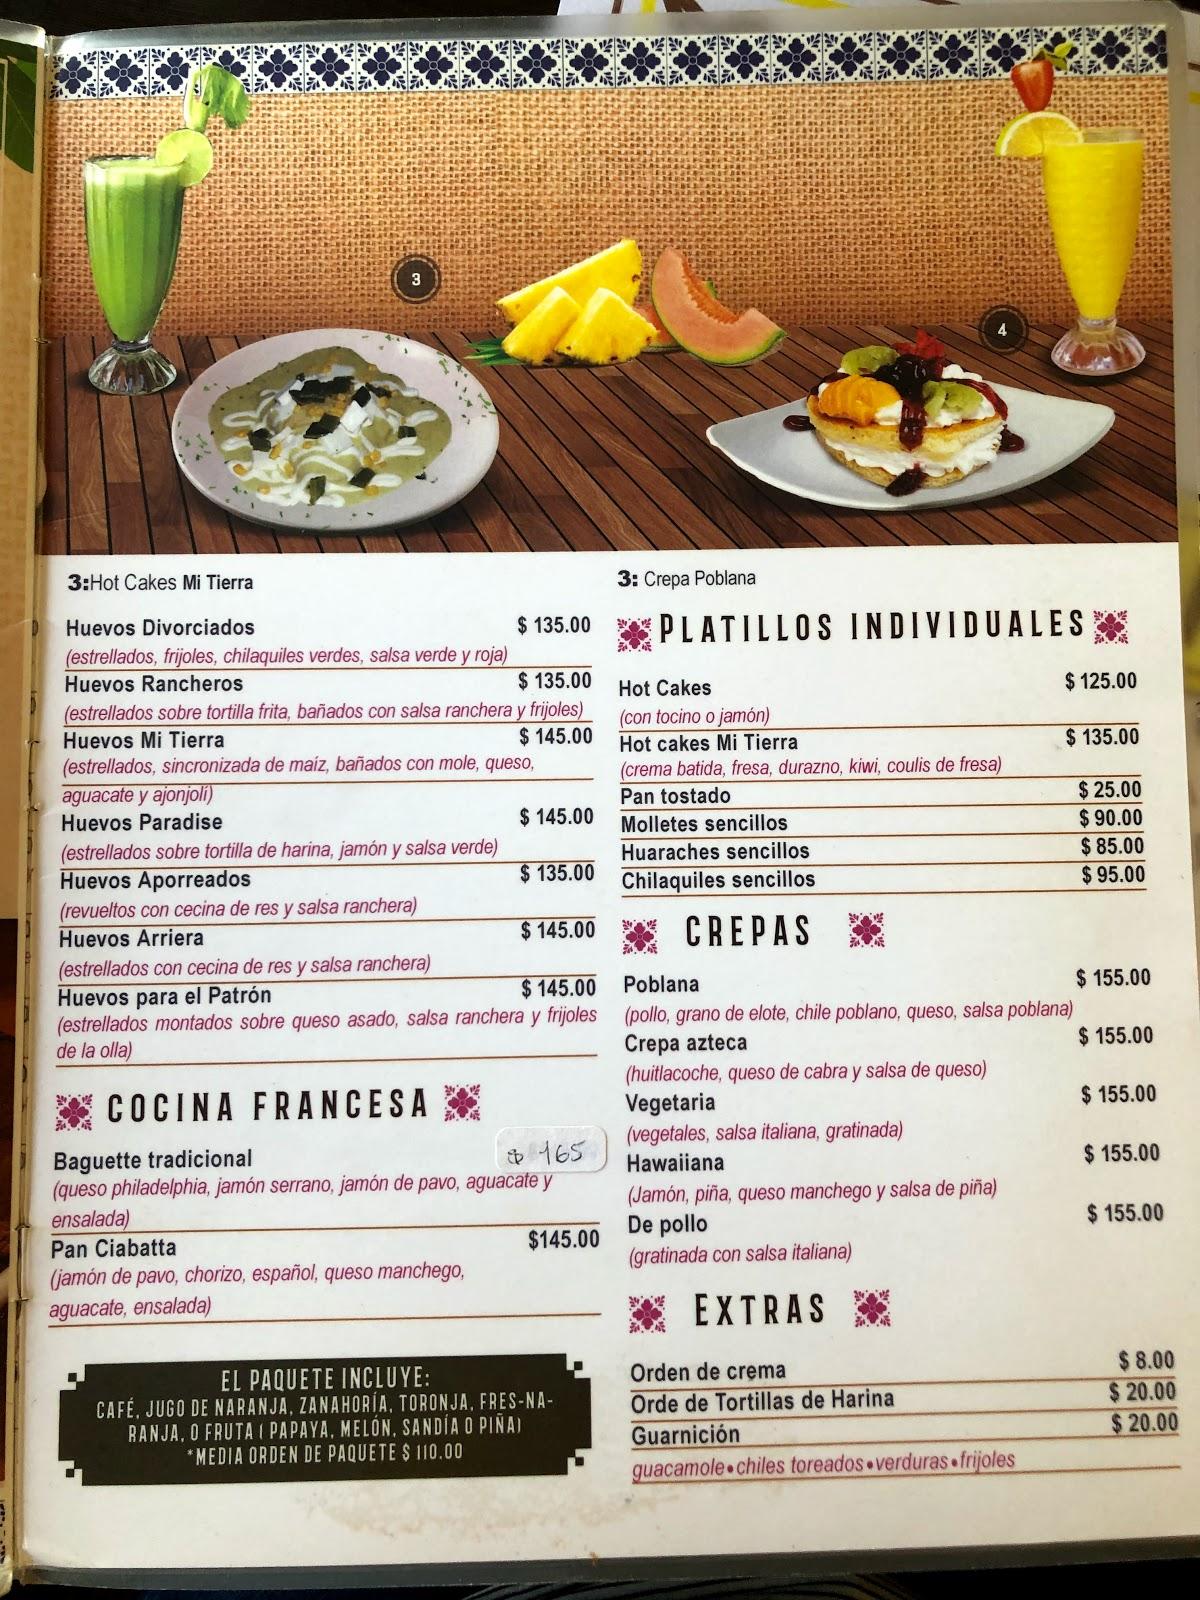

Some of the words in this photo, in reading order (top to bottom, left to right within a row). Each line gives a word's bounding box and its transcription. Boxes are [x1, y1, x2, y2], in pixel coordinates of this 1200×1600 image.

[412, 272, 421, 286] 3
[997, 322, 1007, 337] 4
[124, 573, 176, 591] Cakes
[183, 574, 200, 590] Mi
[205, 574, 253, 590] Tierra
[644, 570, 689, 587] Crepa
[695, 569, 756, 586] Poblana
[66, 618, 135, 637] Huevos
[142, 618, 254, 636] Divorciados
[534, 616, 590, 633] 135.00
[659, 613, 831, 643] PLATILLOS
[851, 609, 1083, 640] INDIVIDUALES
[65, 647, 157, 669] (estrellados,
[163, 647, 217, 668] frijoles,
[223, 647, 304, 667] chilaquiles
[309, 647, 363, 664] verdes,
[369, 646, 410, 663] salsa
[414, 645, 457, 662] verde
[460, 649, 471, 666] y
[474, 645, 507, 666] roja)
[64, 675, 134, 693] Huevos
[141, 675, 243, 692] Rancheros
[656, 678, 711, 696] Cakes
[1080, 672, 1137, 689] 125.00
[619, 709, 651, 727] (con
[656, 708, 701, 724] tocino
[718, 706, 770, 725] jamón)
[63, 731, 133, 749] Huevos
[141, 731, 161, 748] Mi
[168, 731, 224, 748] Tierra
[657, 734, 710, 752] cakes
[717, 733, 737, 751] Mi
[743, 733, 798, 750] Tierra
[620, 761, 672, 781] (crema
[676, 759, 725, 778] batida,
[732, 759, 772, 777] fresa,
[778, 758, 843, 776] durazno,
[849, 757, 881, 775] kiwi,
[887, 756, 931, 773] coulis
[935, 756, 955, 772] de
[959, 755, 1002, 774] fresa)
[62, 787, 134, 807] aguacate
[137, 790, 149, 806] y
[621, 787, 654, 804] Pan
[660, 786, 731, 804] tostado
[1093, 780, 1141, 798] 25.00
[61, 813, 132, 832] Huevos
[139, 812, 223, 831] Paradise
[621, 815, 697, 833] Molletes
[704, 813, 787, 832] sencillos
[621, 842, 719, 861] Huaraches
[726, 841, 809, 860] sencillos
[60, 871, 131, 889] Huevos
[137, 869, 251, 892] Aporreados
[621, 870, 725, 891] Chilaquiles
[731, 869, 815, 888] sencillos
[59, 901, 136, 922] (revueltos
[140, 904, 169, 918] con
[174, 900, 225, 917] cecina
[229, 899, 250, 916] de
[254, 902, 279, 916] res
[282, 902, 294, 919] y
[297, 898, 339, 915] salsa
[343, 896, 417, 917] ranchera)
[59, 929, 130, 948] Huevos
[136, 928, 203, 946] Arriera
[686, 914, 809, 947] CREPAS
[624, 974, 699, 993] Poblana
[1093, 967, 1151, 986] 155.00
[58, 988, 129, 1007] Huevos
[136, 991, 178, 1007] para
[184, 986, 201, 1005] el
[208, 986, 271, 1004] Patrón
[56, 1042, 76, 1059] de
[80, 1042, 95, 1058] la
[99, 1041, 132, 1061] olla)
[624, 1034, 679, 1055] Crepa
[686, 1033, 747, 1051] azteca
[107, 1091, 232, 1123] COCINA
[253, 1088, 427, 1120] FRANCESA
[625, 1092, 715, 1115] Vegetaria
[626, 1123, 709, 1146] (vegetales,
[715, 1123, 756, 1141] salsa
[761, 1122, 819, 1141] italiana,
[825, 1120, 903, 1143] gratinada)
[53, 1151, 141, 1172] Baguette
[147, 1148, 251, 1168] tradicional
[539, 1140, 585, 1165] 165
[627, 1153, 724, 1173] Hawaiiana
[51, 1209, 130, 1230] ensalada)
[628, 1215, 653, 1233] De
[660, 1213, 707, 1235] pollo
[51, 1239, 87, 1259] Pan
[95, 1238, 176, 1258] Ciabatta
[528, 1228, 599, 1250] $145.00
[629, 1246, 708, 1269] (gratinada
[712, 1248, 741, 1263] con
[745, 1245, 787, 1262] salsa
[791, 1243, 852, 1264] italiana)
[48, 1298, 126, 1320] aguacate,
[133, 1297, 211, 1318] ensalada)
[695, 1293, 824, 1326] EXTRAS
[1135, 1351, 1174, 1369] 8.00
[221, 1369, 241, 1392] EL
[250, 1368, 333, 1391] PAQUETE
[342, 1367, 429, 1389] INCLUYE:
[630, 1362, 690, 1383] Orden
[696, 1362, 720, 1381] de
[726, 1364, 786, 1381] crema
[96, 1400, 139, 1419] CAFÉ,
[145, 1399, 184, 1418] JUGO
[191, 1398, 208, 1417] DE
[214, 1396, 293, 1416] NARANJA,
[299, 1394, 392, 1414] ZANAHORÍA,
[398, 1392, 473, 1412] TORONJA,
[631, 1395, 678, 1414] Orde
[685, 1394, 708, 1412] de
[715, 1392, 794, 1412] Tortillas
[801, 1391, 825, 1409] de
[831, 1390, 894, 1408] Harina
[128, 1423, 184, 1442] RANJA,
[190, 1422, 198, 1441] O
[205, 1421, 253, 1441] FRUTA
[269, 1419, 333, 1439] PAPAYA,
[340, 1418, 396, 1438] MELÓN,
[402, 1416, 458, 1436] SANDÍA
[464, 1416, 472, 1434] O
[631, 1424, 740, 1445] Guarnición
[249, 1445, 298, 1464] ORDEN
[304, 1445, 321, 1463] DE
[328, 1444, 396, 1463] PAQUETE
[416, 1442, 462, 1460] 110.00
